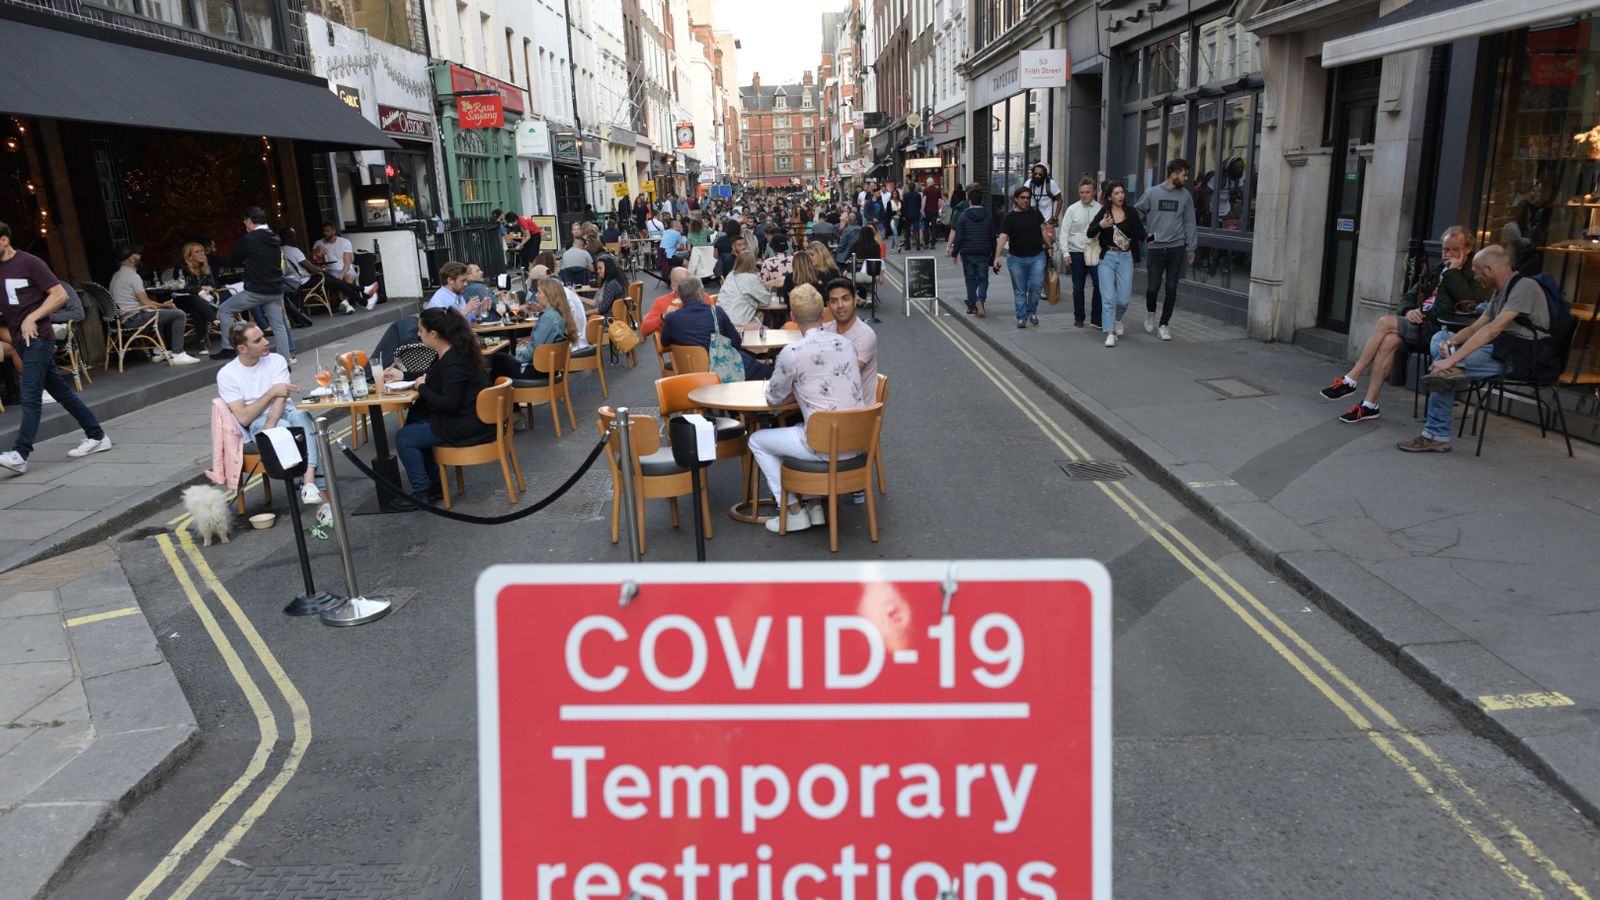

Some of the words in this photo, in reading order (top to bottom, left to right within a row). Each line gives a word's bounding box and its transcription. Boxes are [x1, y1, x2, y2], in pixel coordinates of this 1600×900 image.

[1024, 67, 1040, 75] Frith
[1041, 67, 1062, 75] Street
[465, 110, 498, 126] Sayang
[472, 101, 495, 113] Rasa
[565, 613, 1024, 692] COVID-19
[552, 746, 1037, 833] Temporary
[537, 844, 1057, 900] restrictions
